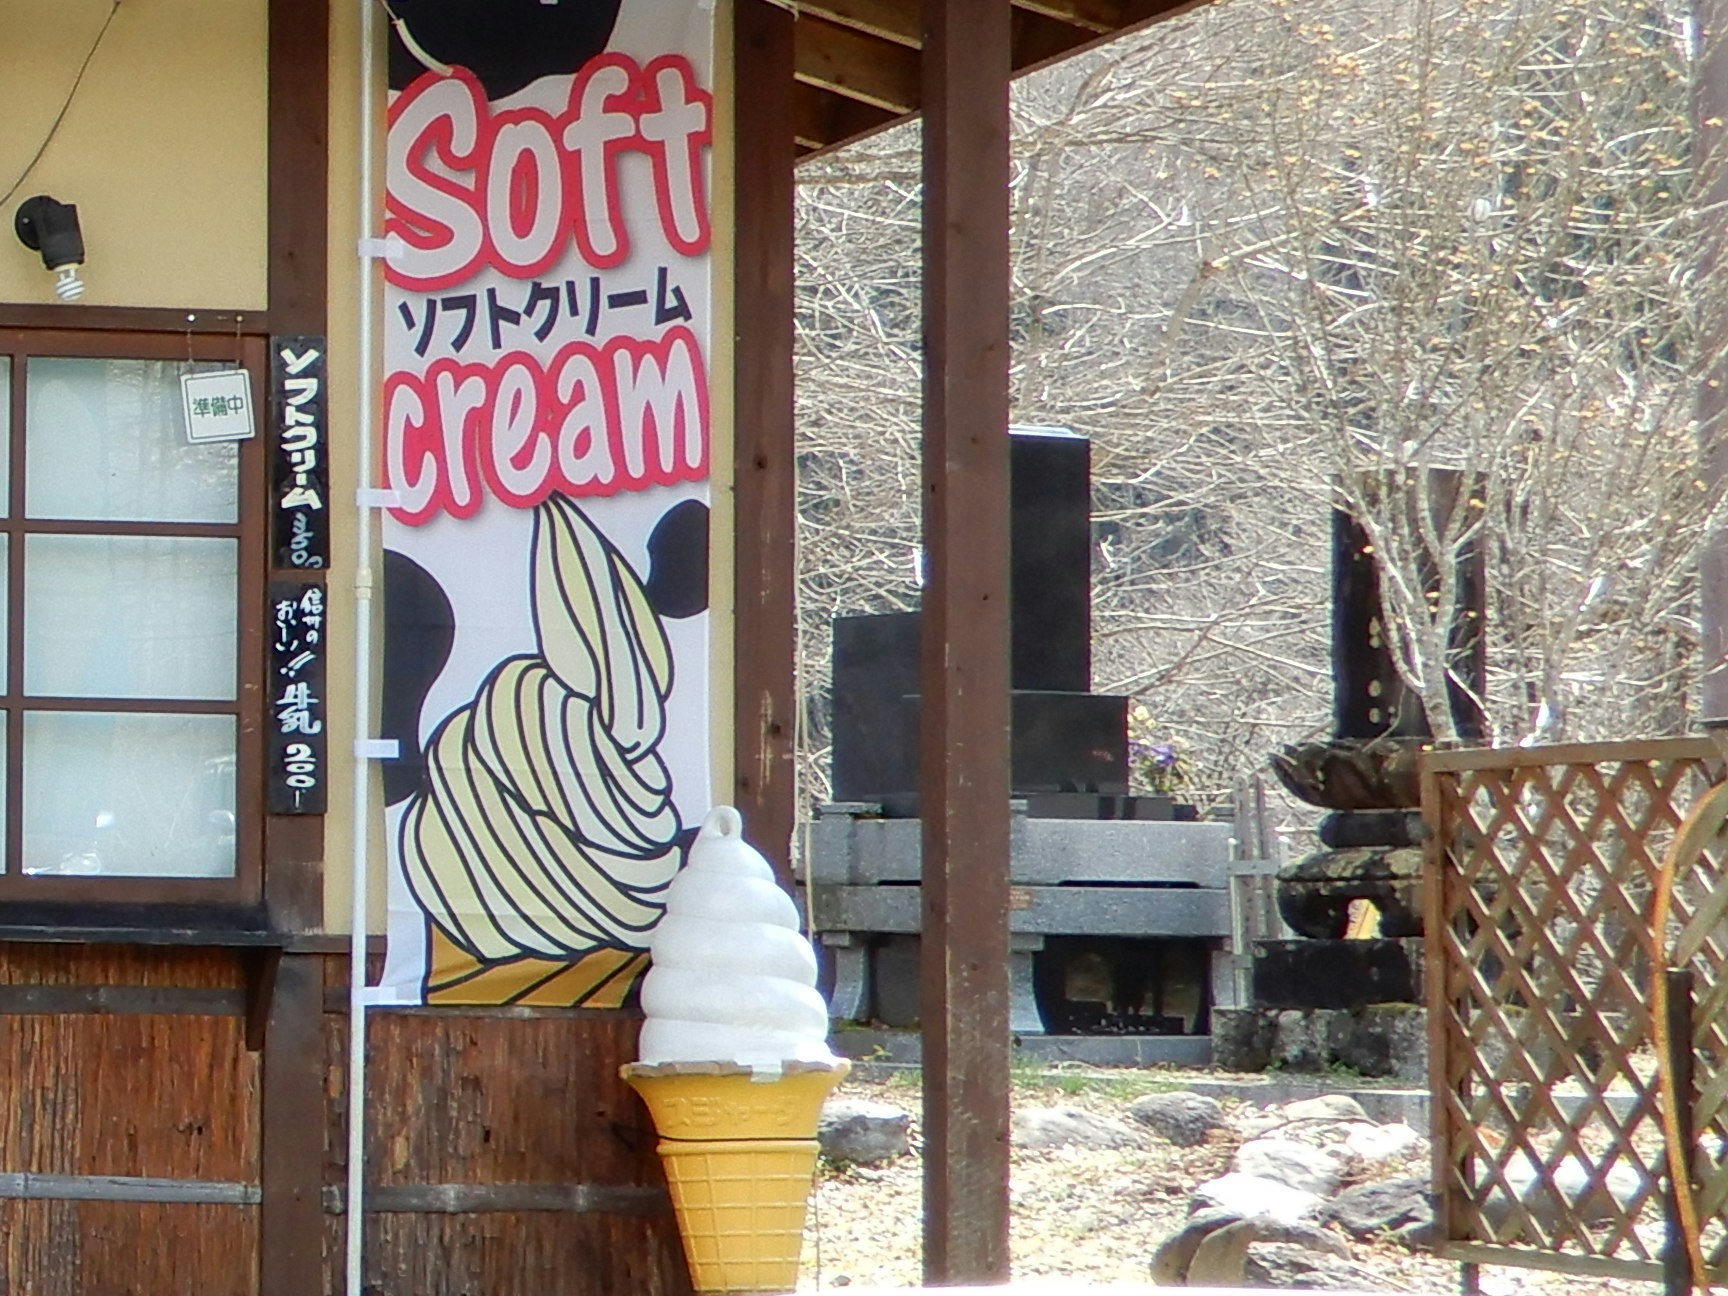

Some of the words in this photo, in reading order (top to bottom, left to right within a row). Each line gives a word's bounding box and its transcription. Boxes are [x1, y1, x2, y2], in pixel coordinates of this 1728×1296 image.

[385, 52, 713, 292] Soft
[398, 267, 693, 358] ソフトクリーム
[192, 395, 245, 418] 準備中
[280, 347, 321, 510] ソフトクリーム
[385, 325, 711, 528] cream
